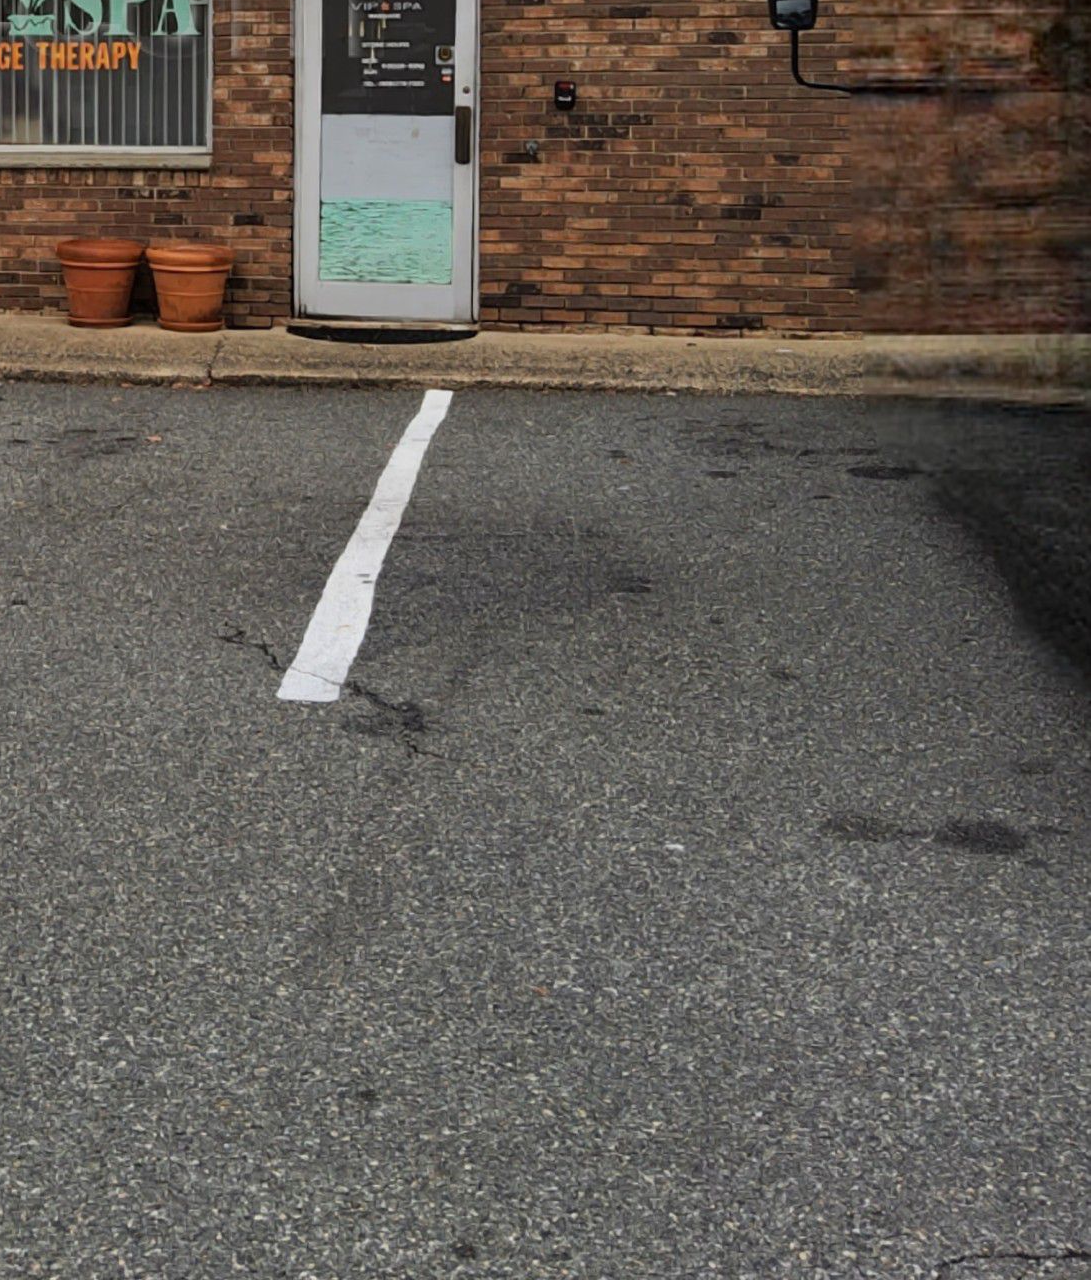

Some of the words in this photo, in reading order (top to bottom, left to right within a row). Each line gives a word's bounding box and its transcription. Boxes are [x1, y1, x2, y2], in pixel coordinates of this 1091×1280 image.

[351, 1, 379, 11] VIP
[393, 1, 423, 11] SPA
[36, 41, 142, 71] THERAPY
